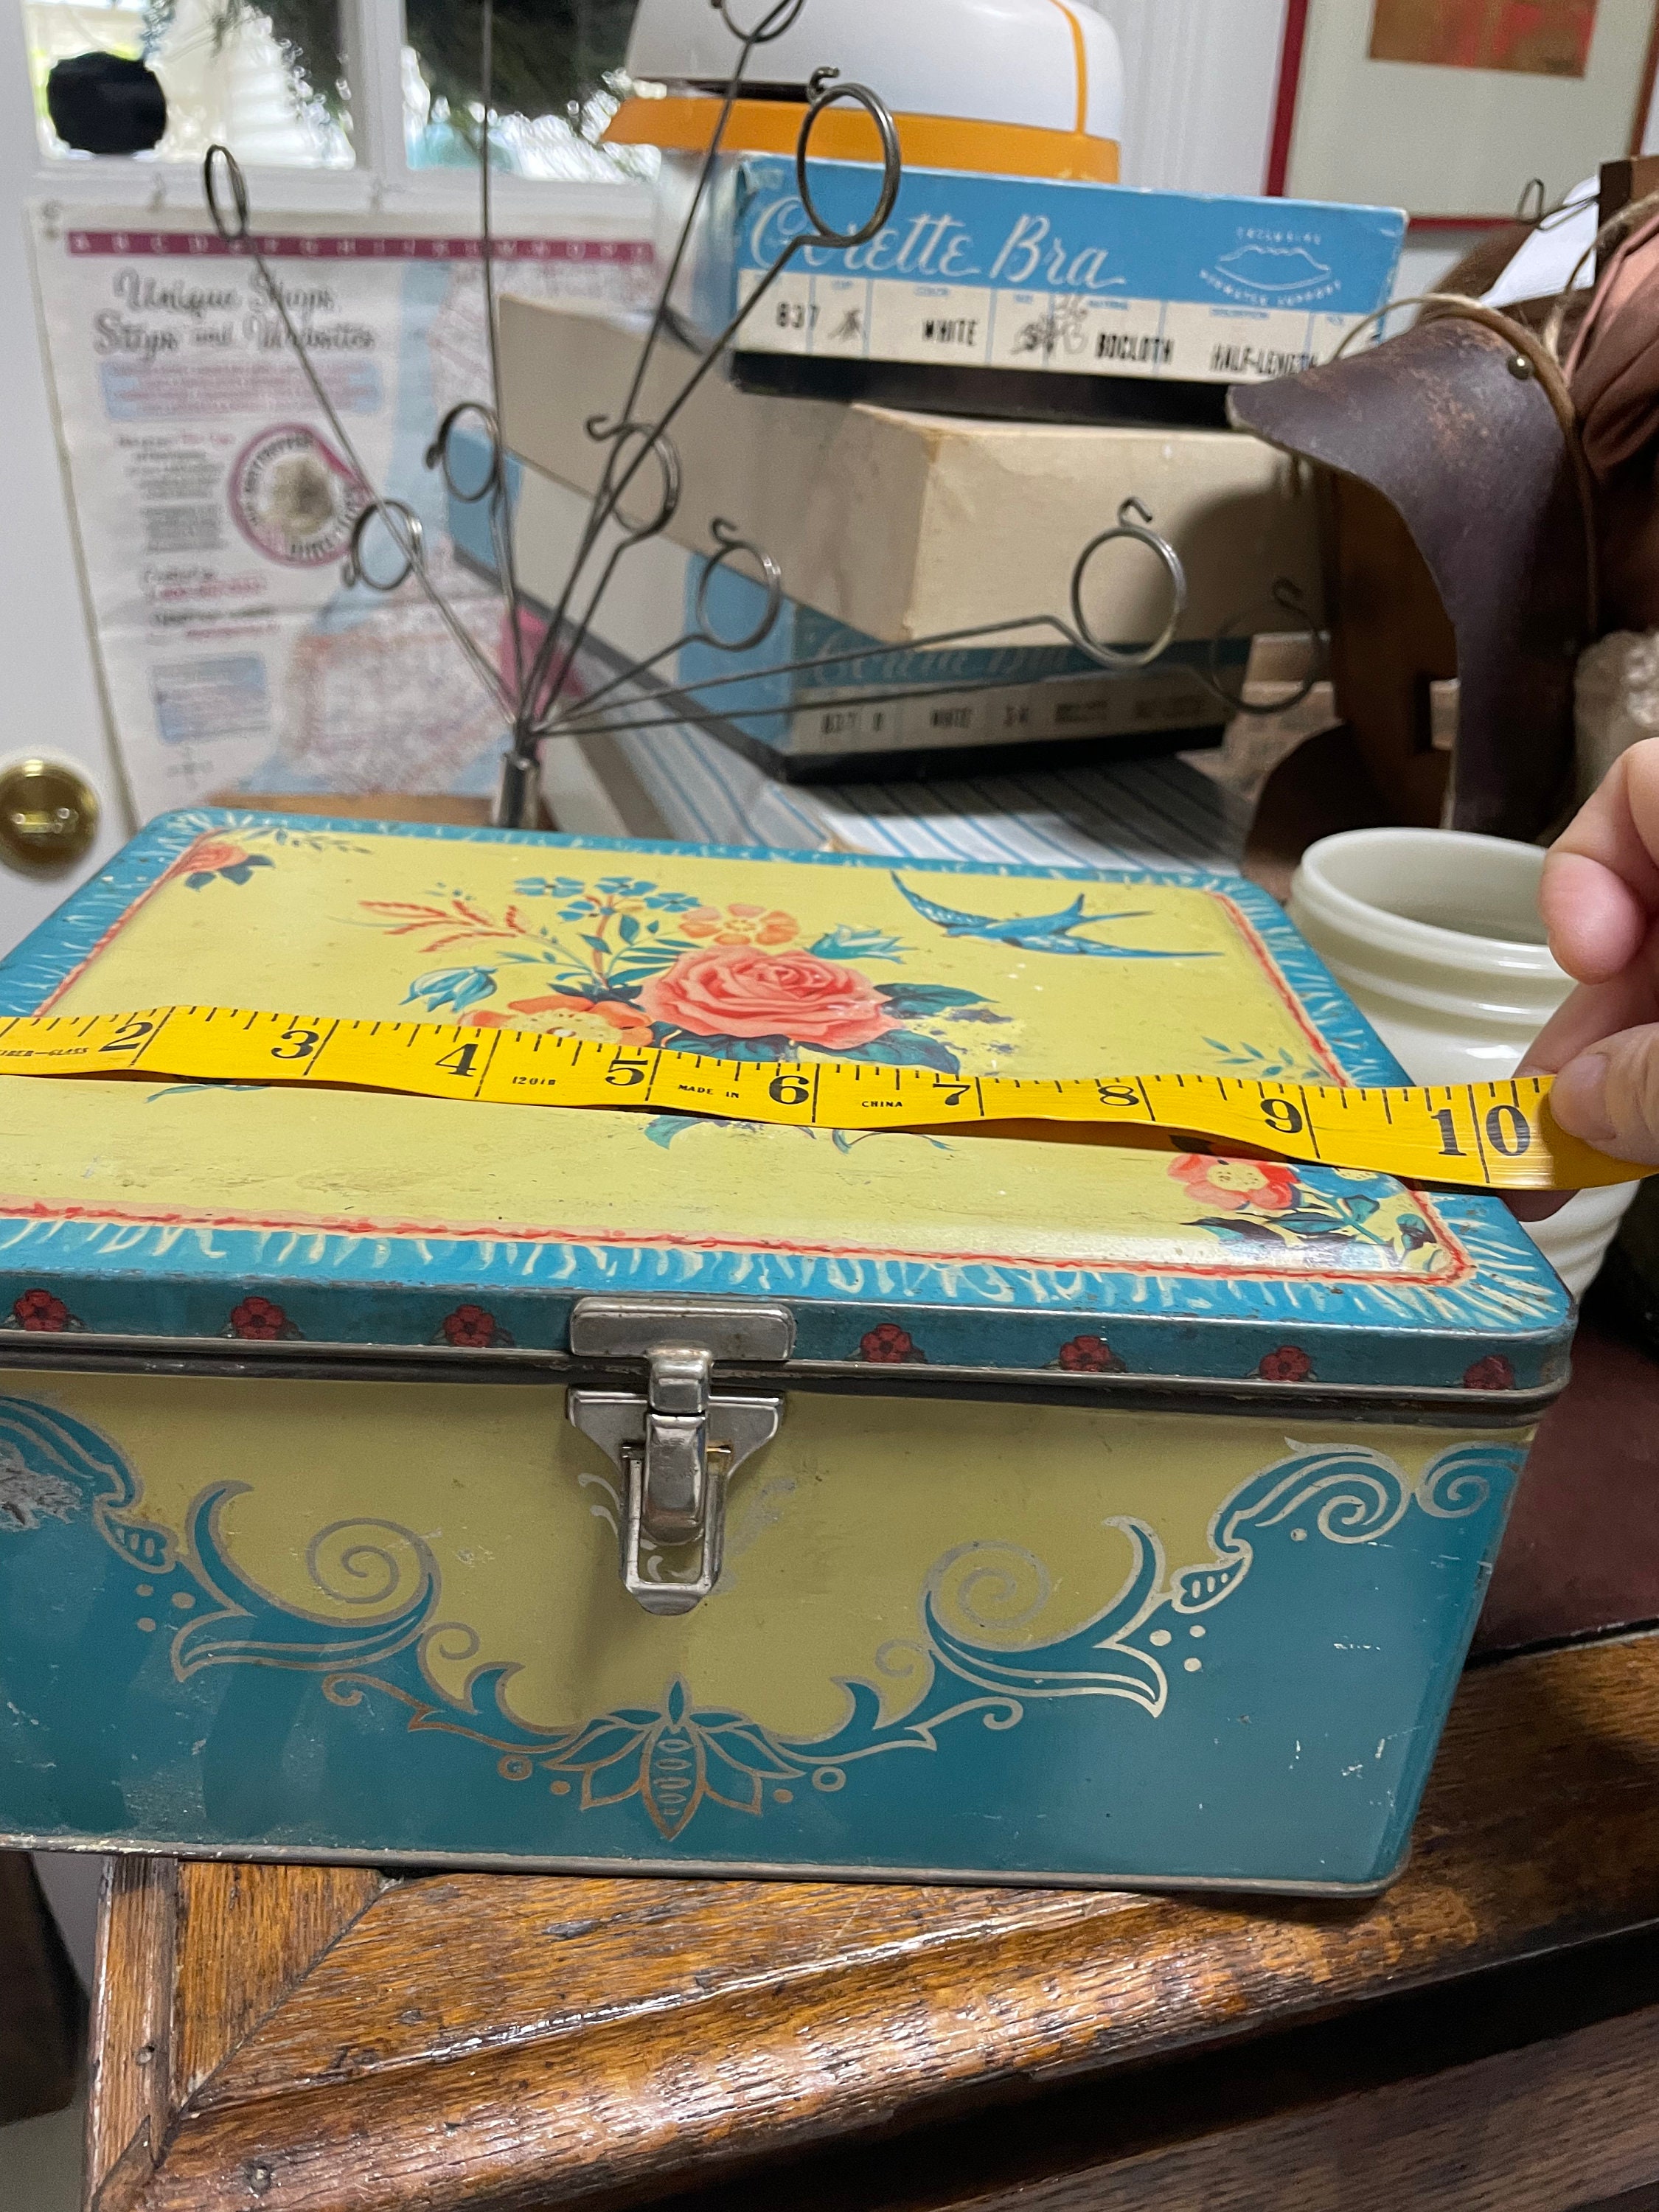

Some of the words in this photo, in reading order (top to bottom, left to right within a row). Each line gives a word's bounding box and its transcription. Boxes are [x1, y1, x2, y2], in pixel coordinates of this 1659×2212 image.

[989, 212, 1126, 289] Bra
[923, 319, 978, 346] WHITE
[99, 1022, 153, 1052] 2
[271, 1029, 319, 1059] 3
[435, 1043, 479, 1077] 4
[605, 1059, 648, 1086] 5
[768, 1075, 810, 1105] 6
[932, 1082, 971, 1106] 7
[1098, 1085, 1140, 1107] 8
[1261, 1098, 1303, 1134] 9
[1430, 1105, 1531, 1156] 10
[678, 1085, 714, 1095] MADE
